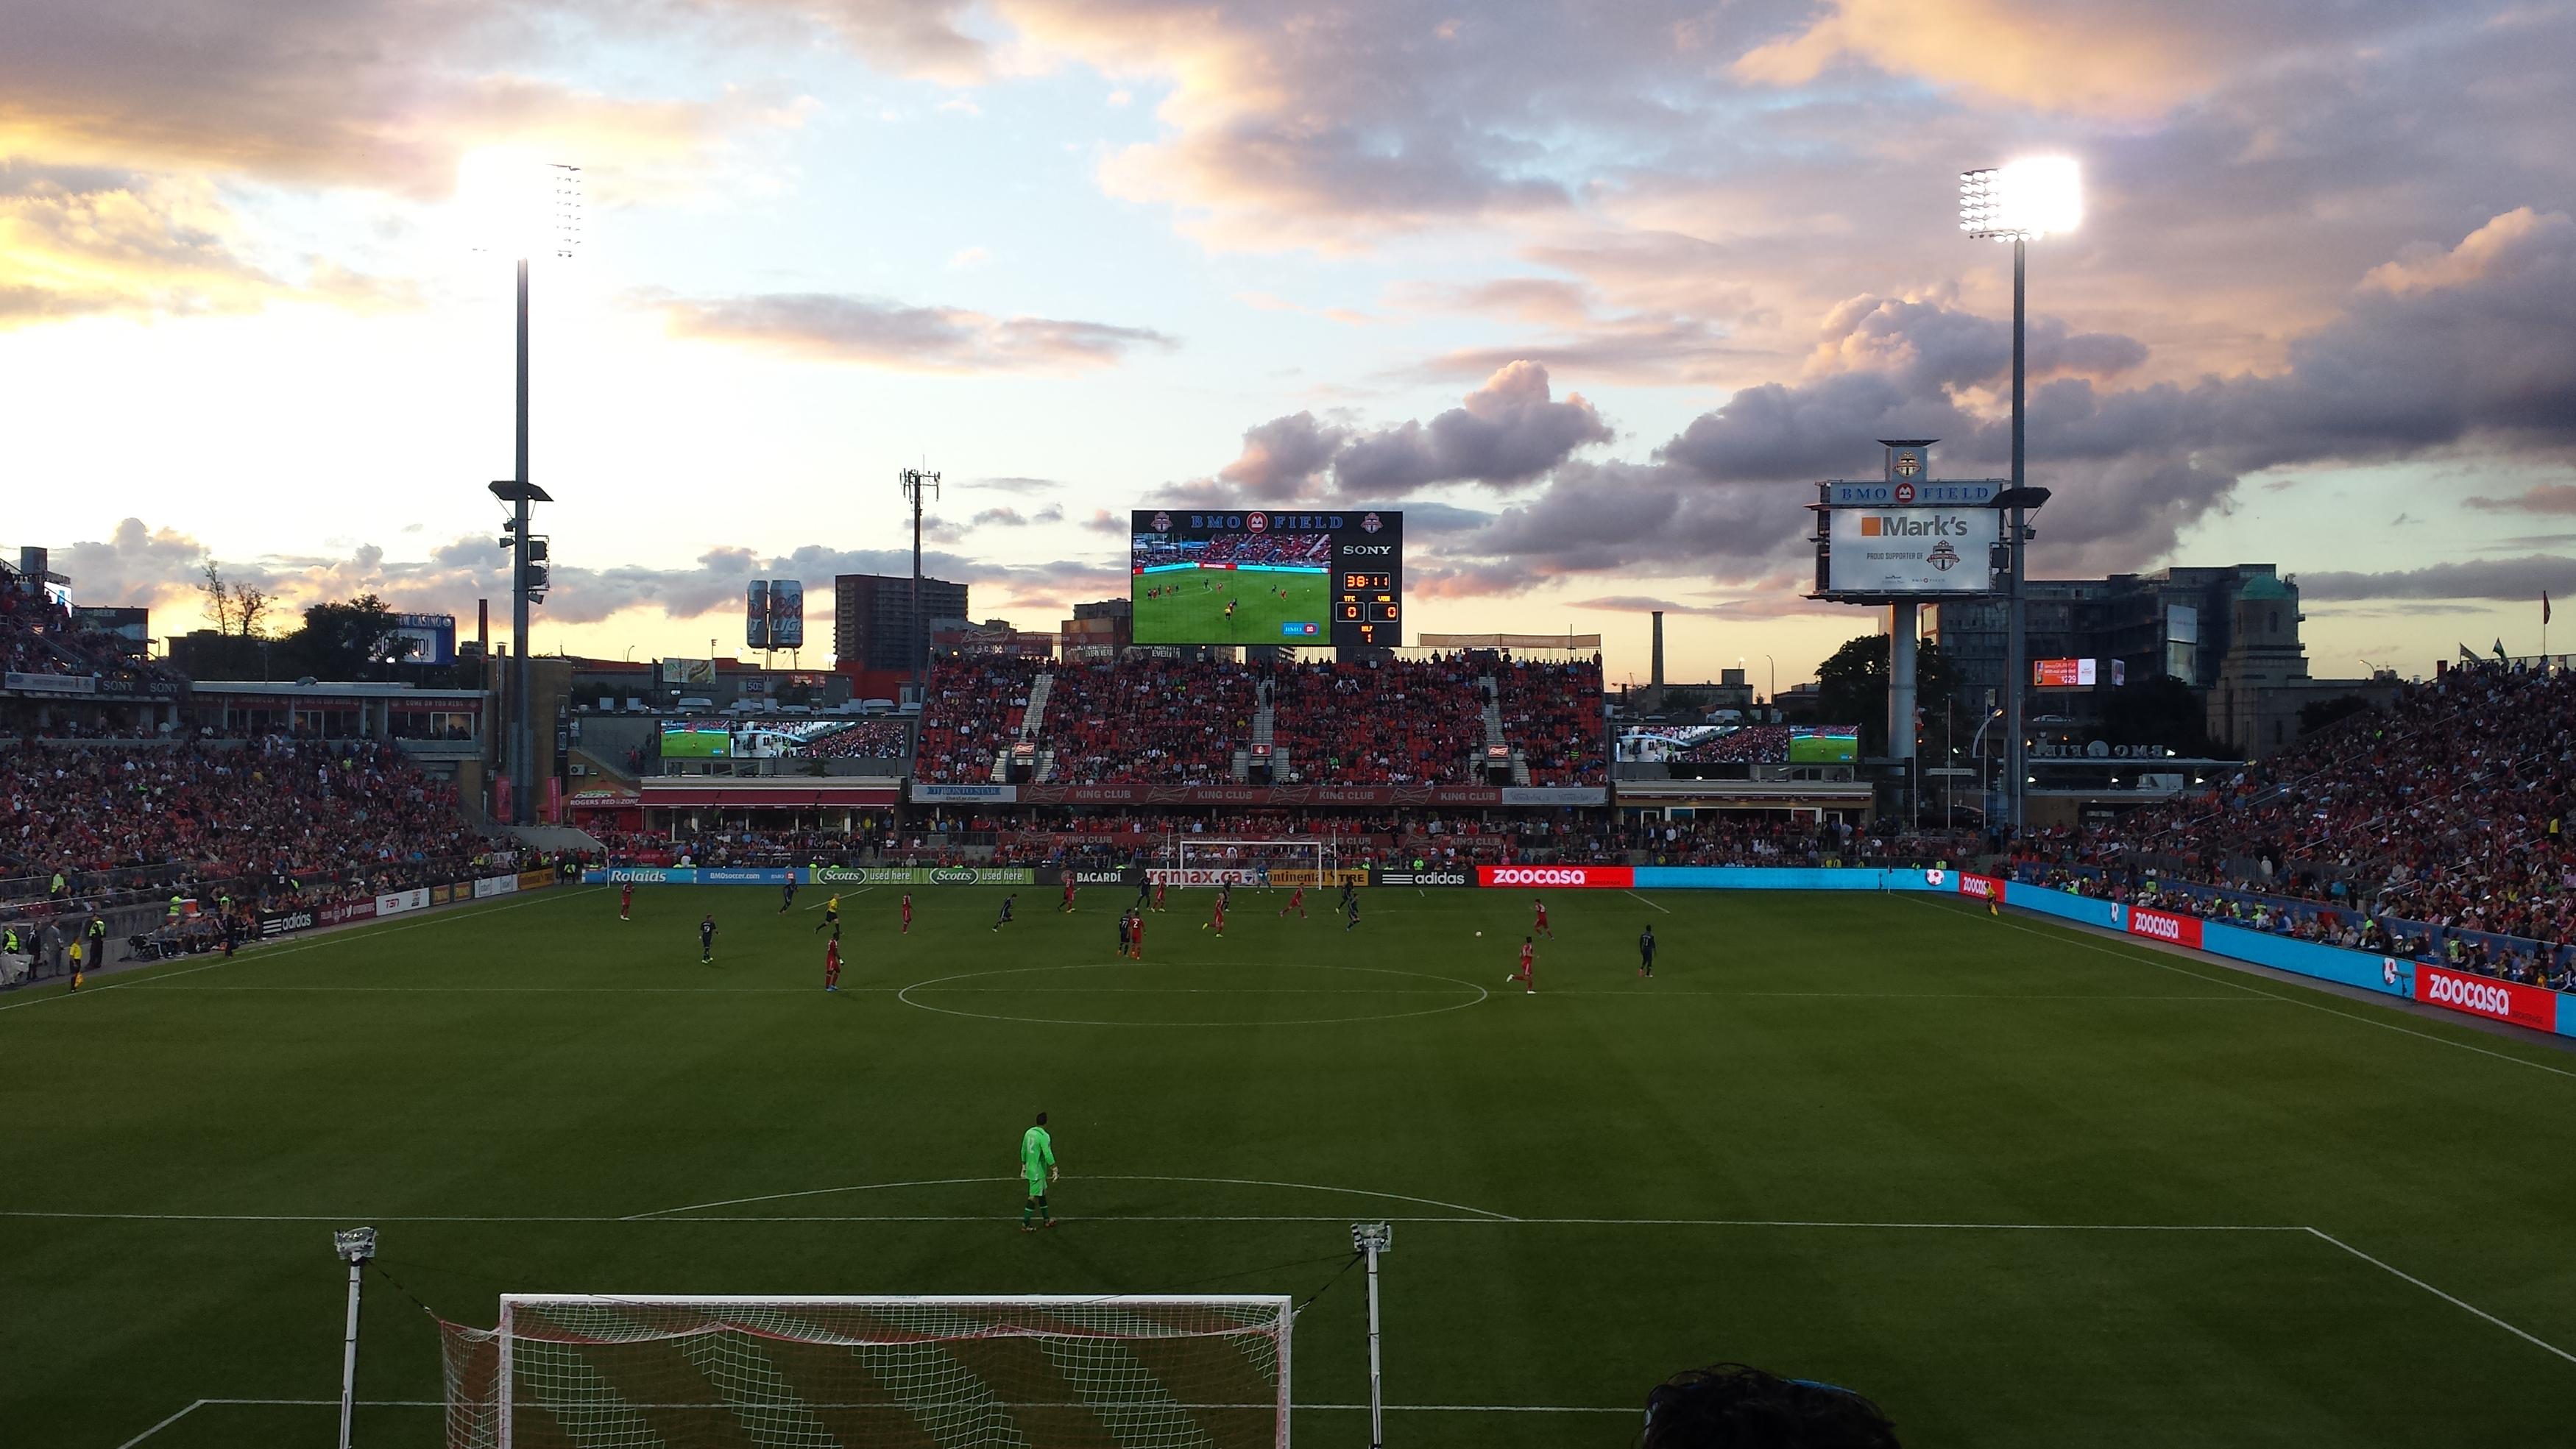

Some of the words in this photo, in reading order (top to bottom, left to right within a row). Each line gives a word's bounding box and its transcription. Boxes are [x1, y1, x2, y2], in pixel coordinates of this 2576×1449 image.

[1842, 487, 1886, 500] BMO
[1924, 486, 1988, 499] FIELD
[1191, 515, 1241, 528] BMO
[1274, 516, 1343, 528] FIELD
[1883, 514, 1968, 536] Mark's
[1343, 545, 1391, 555] SONY
[1347, 575, 1389, 587] 38:11
[1348, 606, 1356, 617] 0
[1387, 606, 1396, 617] 0
[103, 680, 134, 691] SONY
[149, 682, 179, 693] SONY
[1076, 790, 1101, 798] KING
[1104, 790, 1131, 798] CLUB
[1197, 790, 1222, 799] KING
[1225, 790, 1253, 800] CLUB
[1318, 791, 1344, 800] KING
[1348, 791, 1374, 800] CLUB
[1440, 792, 1466, 801] KING
[1469, 792, 1496, 801] CLUB
[1087, 836, 1113, 844] CLUB
[1450, 837, 1473, 846] KING
[1475, 837, 1501, 846] CLUB
[610, 869, 667, 883] Rolaids
[710, 871, 760, 880] BMOsoccer.com
[823, 870, 860, 881] Scotts
[869, 869, 890, 880] used
[935, 870, 972, 881] Scotts
[982, 870, 1002, 881] used
[1339, 873, 1365, 882] TIRE
[1415, 871, 1466, 885] adidas
[1493, 869, 1587, 885] zoocasa
[282, 912, 312, 931] adidas
[2135, 912, 2179, 940] zoocasa
[2430, 974, 2510, 1016] zoocasa
